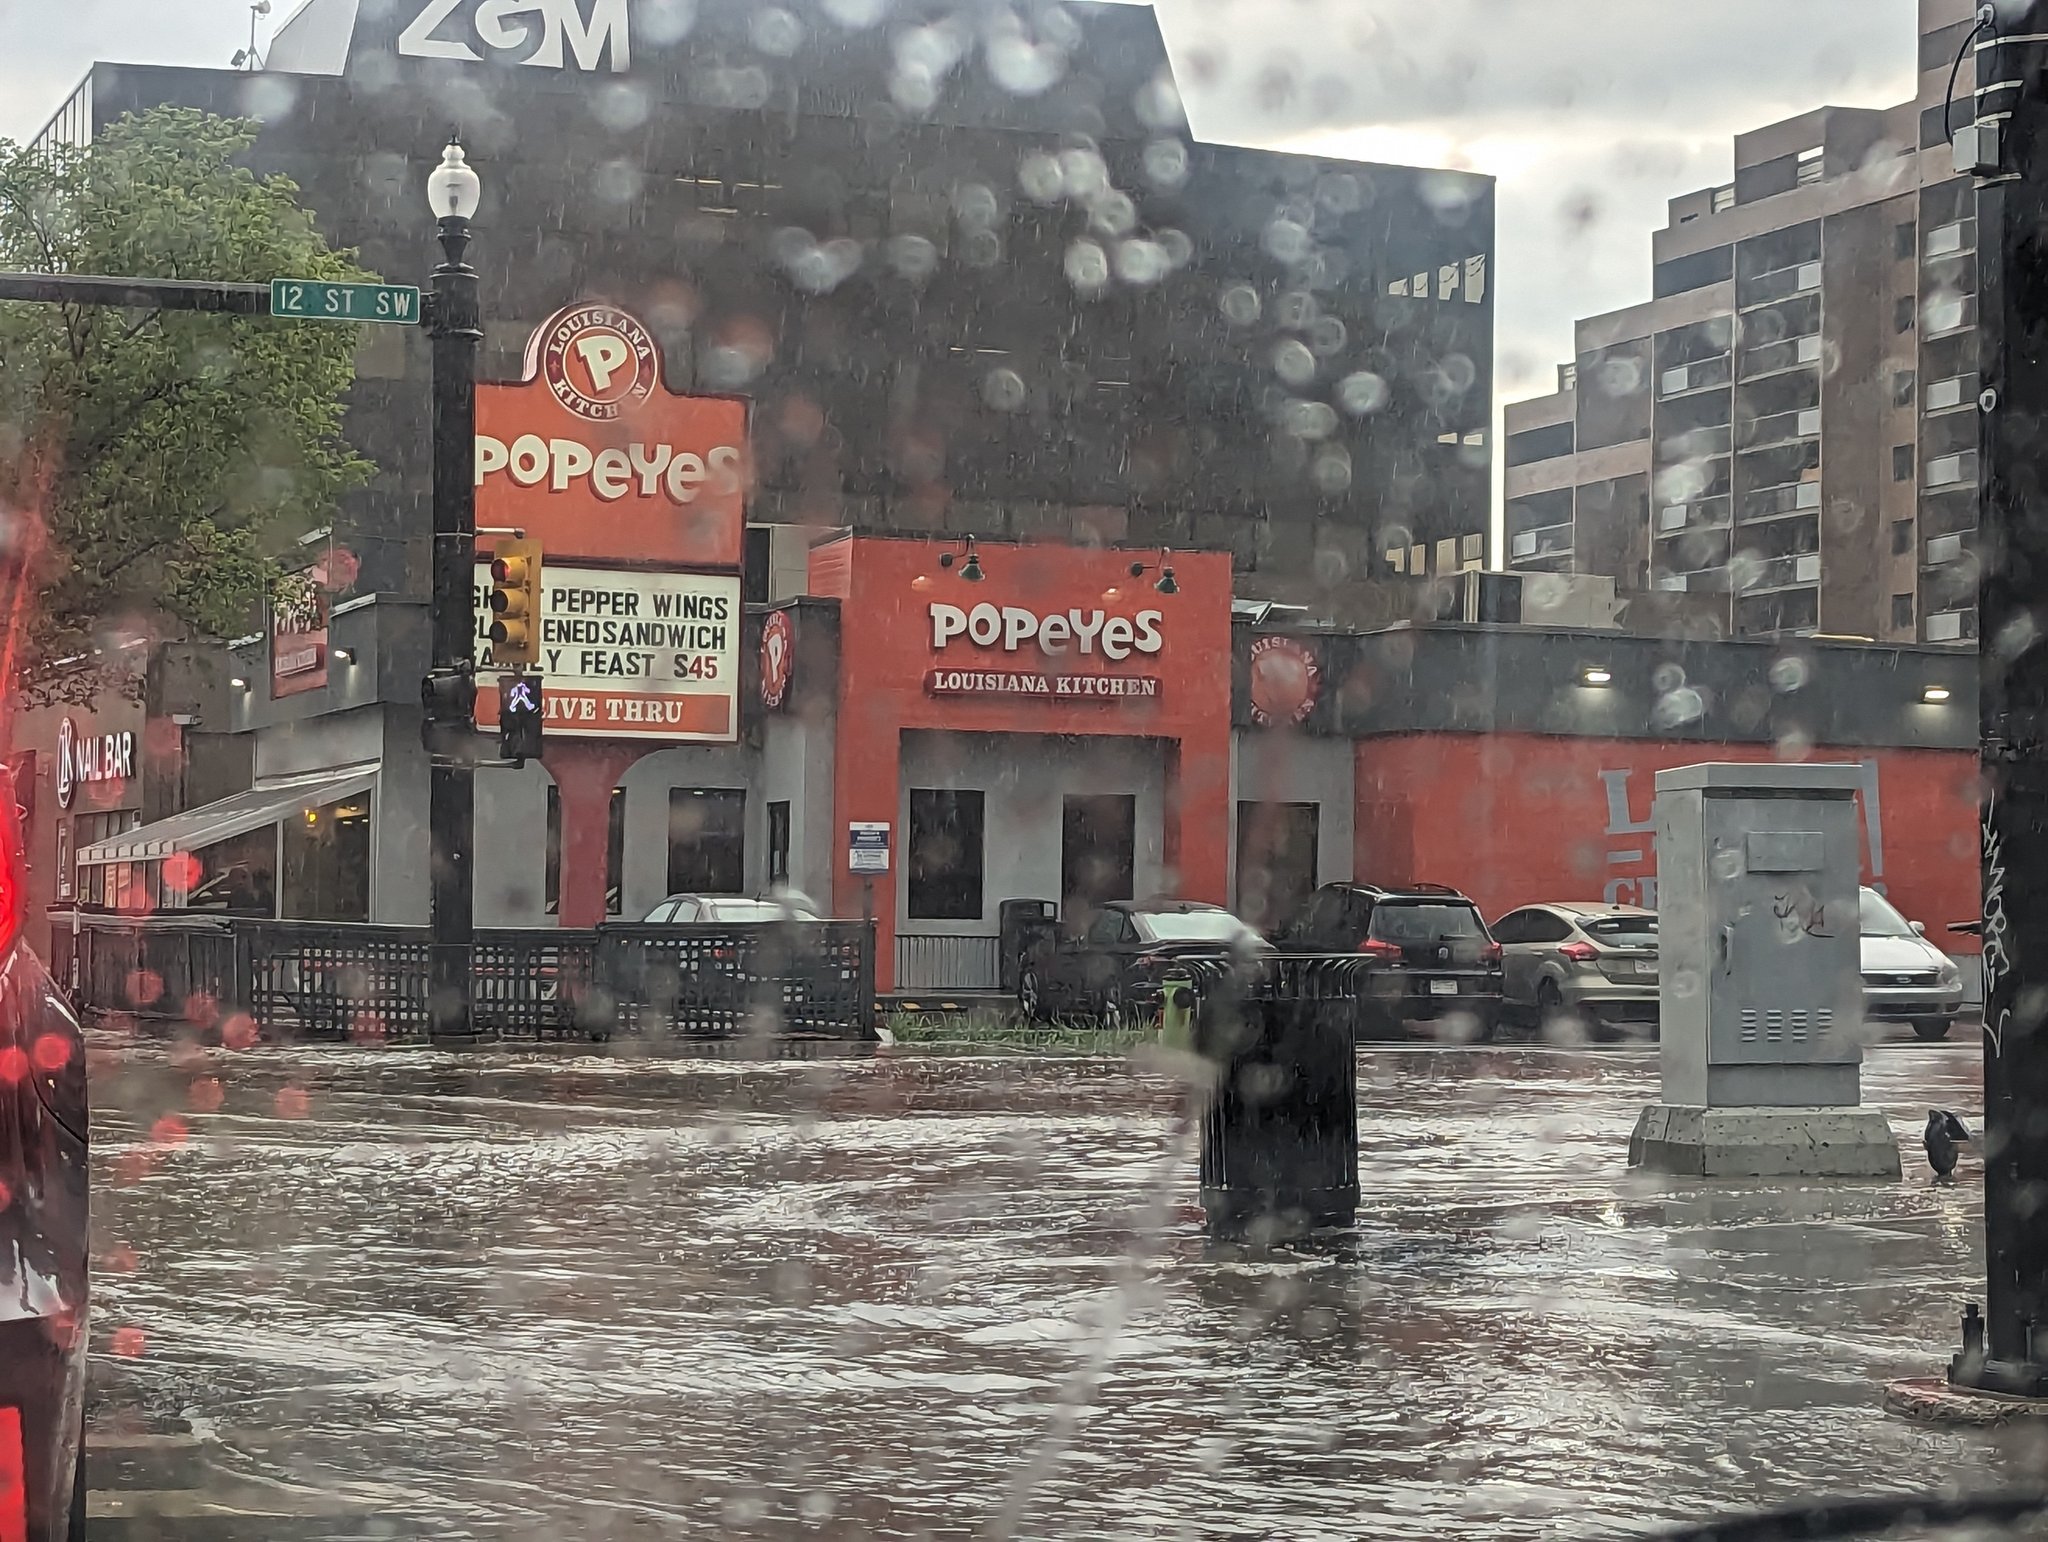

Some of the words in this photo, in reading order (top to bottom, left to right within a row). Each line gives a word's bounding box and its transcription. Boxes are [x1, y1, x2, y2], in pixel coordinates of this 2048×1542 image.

[281, 285, 304, 310] 12
[325, 289, 355, 313] ST
[376, 291, 411, 318] SW
[550, 311, 651, 360] LOUISIANA
[576, 335, 628, 391] P
[552, 378, 648, 418] KITCHN
[552, 588, 639, 616] PEPPER
[653, 594, 728, 620] WINGS
[581, 650, 655, 677] FEAST
[934, 672, 1049, 693] LOUISIANA
[1056, 676, 1157, 696] KITCHEN
[606, 698, 684, 724] THRU
[76, 736, 102, 782] NAIL
[105, 731, 131, 779] BAR
